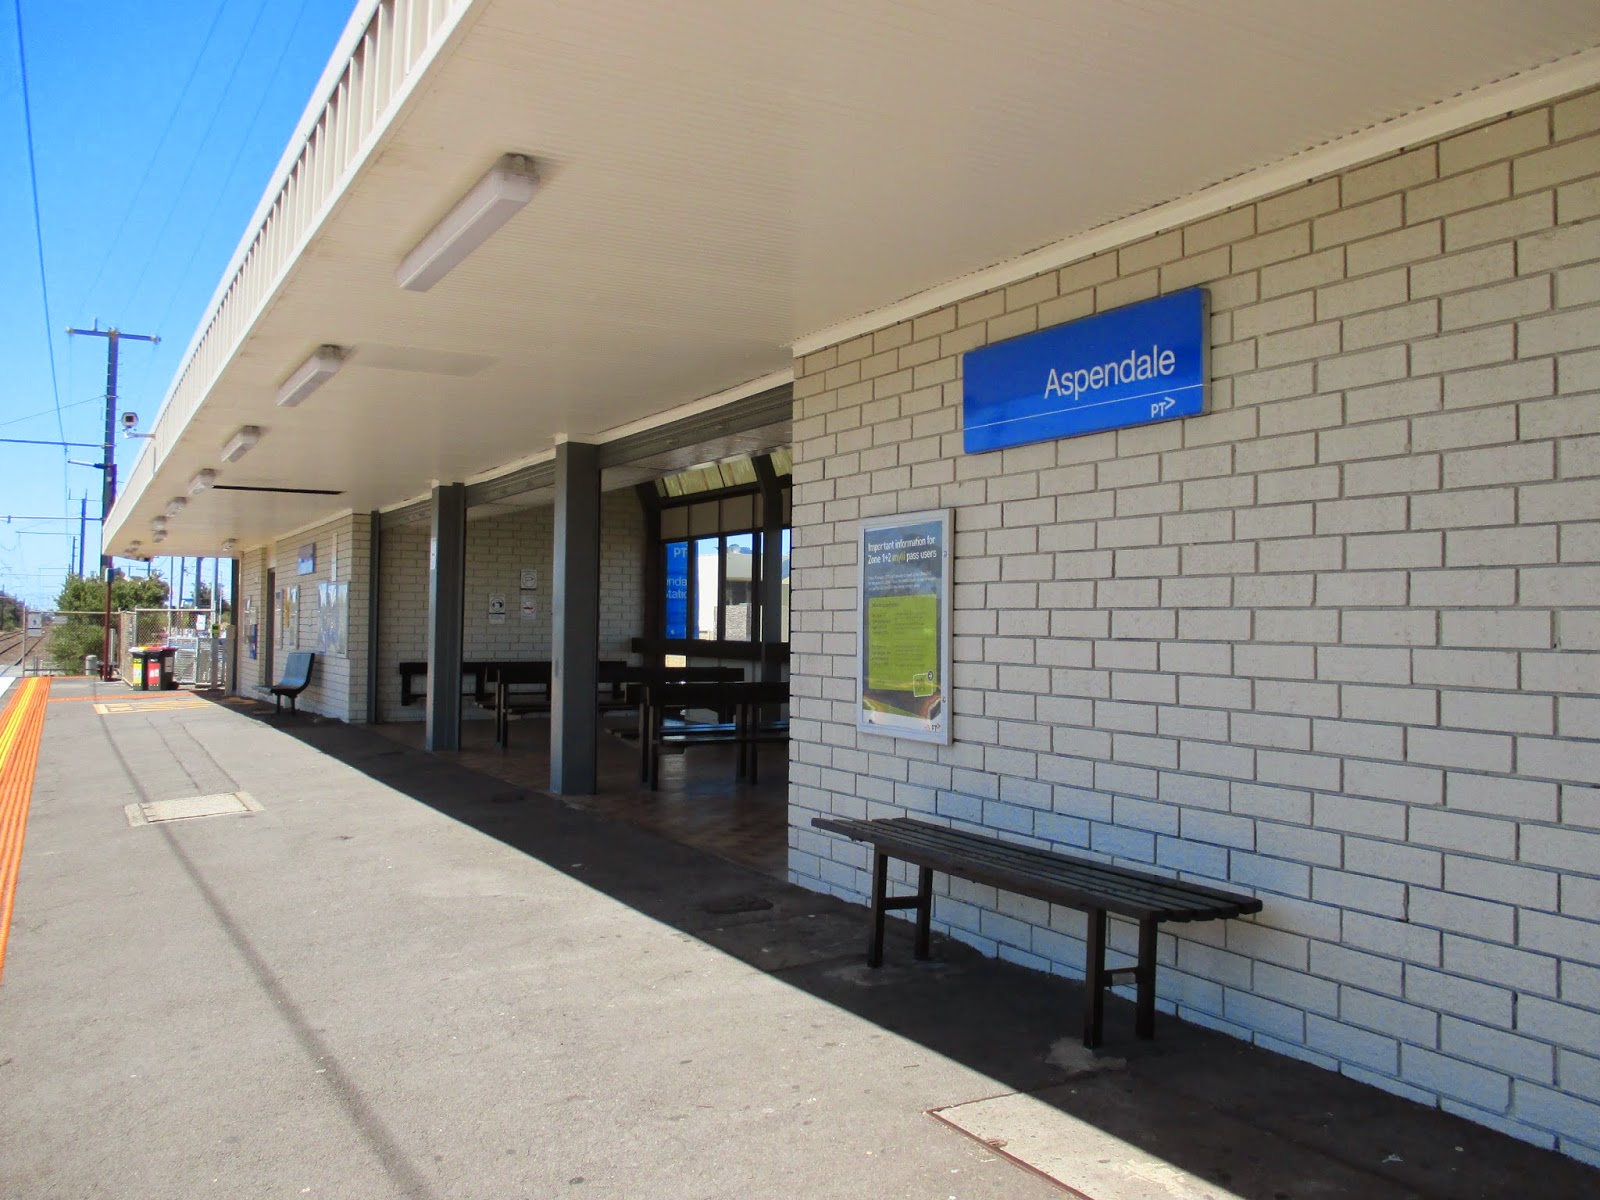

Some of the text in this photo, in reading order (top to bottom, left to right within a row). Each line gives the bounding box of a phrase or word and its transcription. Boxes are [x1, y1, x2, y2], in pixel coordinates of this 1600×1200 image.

[1044, 344, 1176, 400] Aspendale
[868, 535, 936, 553] Important information for
[867, 554, 881, 565] Zone
[882, 552, 892, 563] 1+2
[906, 552, 920, 563] pass
[920, 549, 937, 559] users
